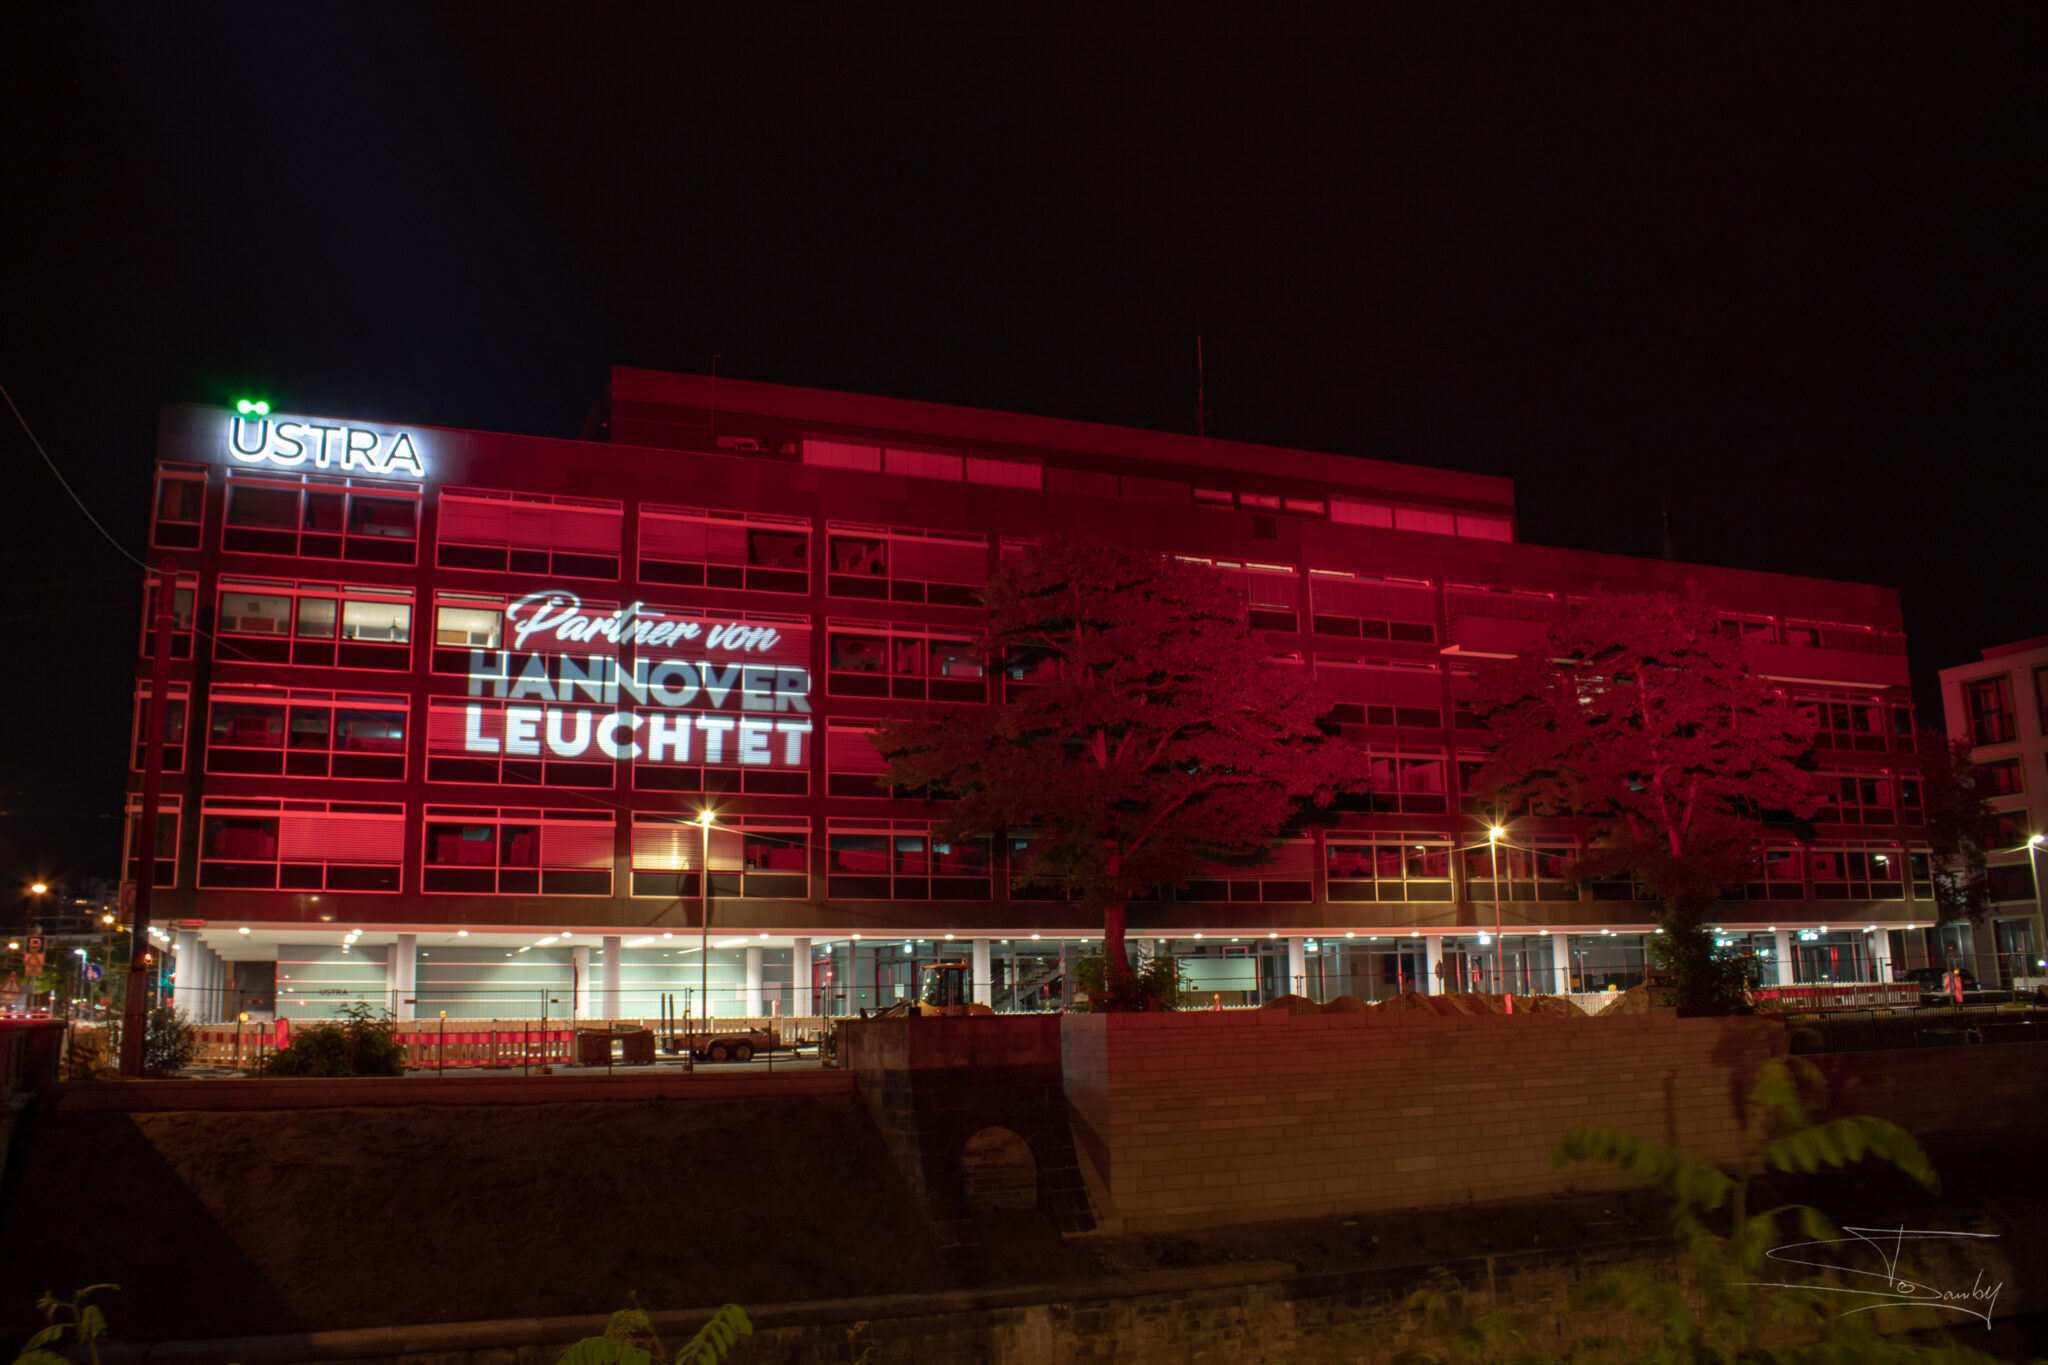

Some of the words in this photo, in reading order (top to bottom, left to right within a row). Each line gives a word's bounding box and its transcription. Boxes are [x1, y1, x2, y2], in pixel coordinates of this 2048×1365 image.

[229, 399, 425, 477] ÜSTRA
[506, 590, 702, 651] Partner
[705, 622, 780, 653] von
[467, 650, 812, 713] HANNOVER
[464, 704, 812, 766] LEUCHTET
